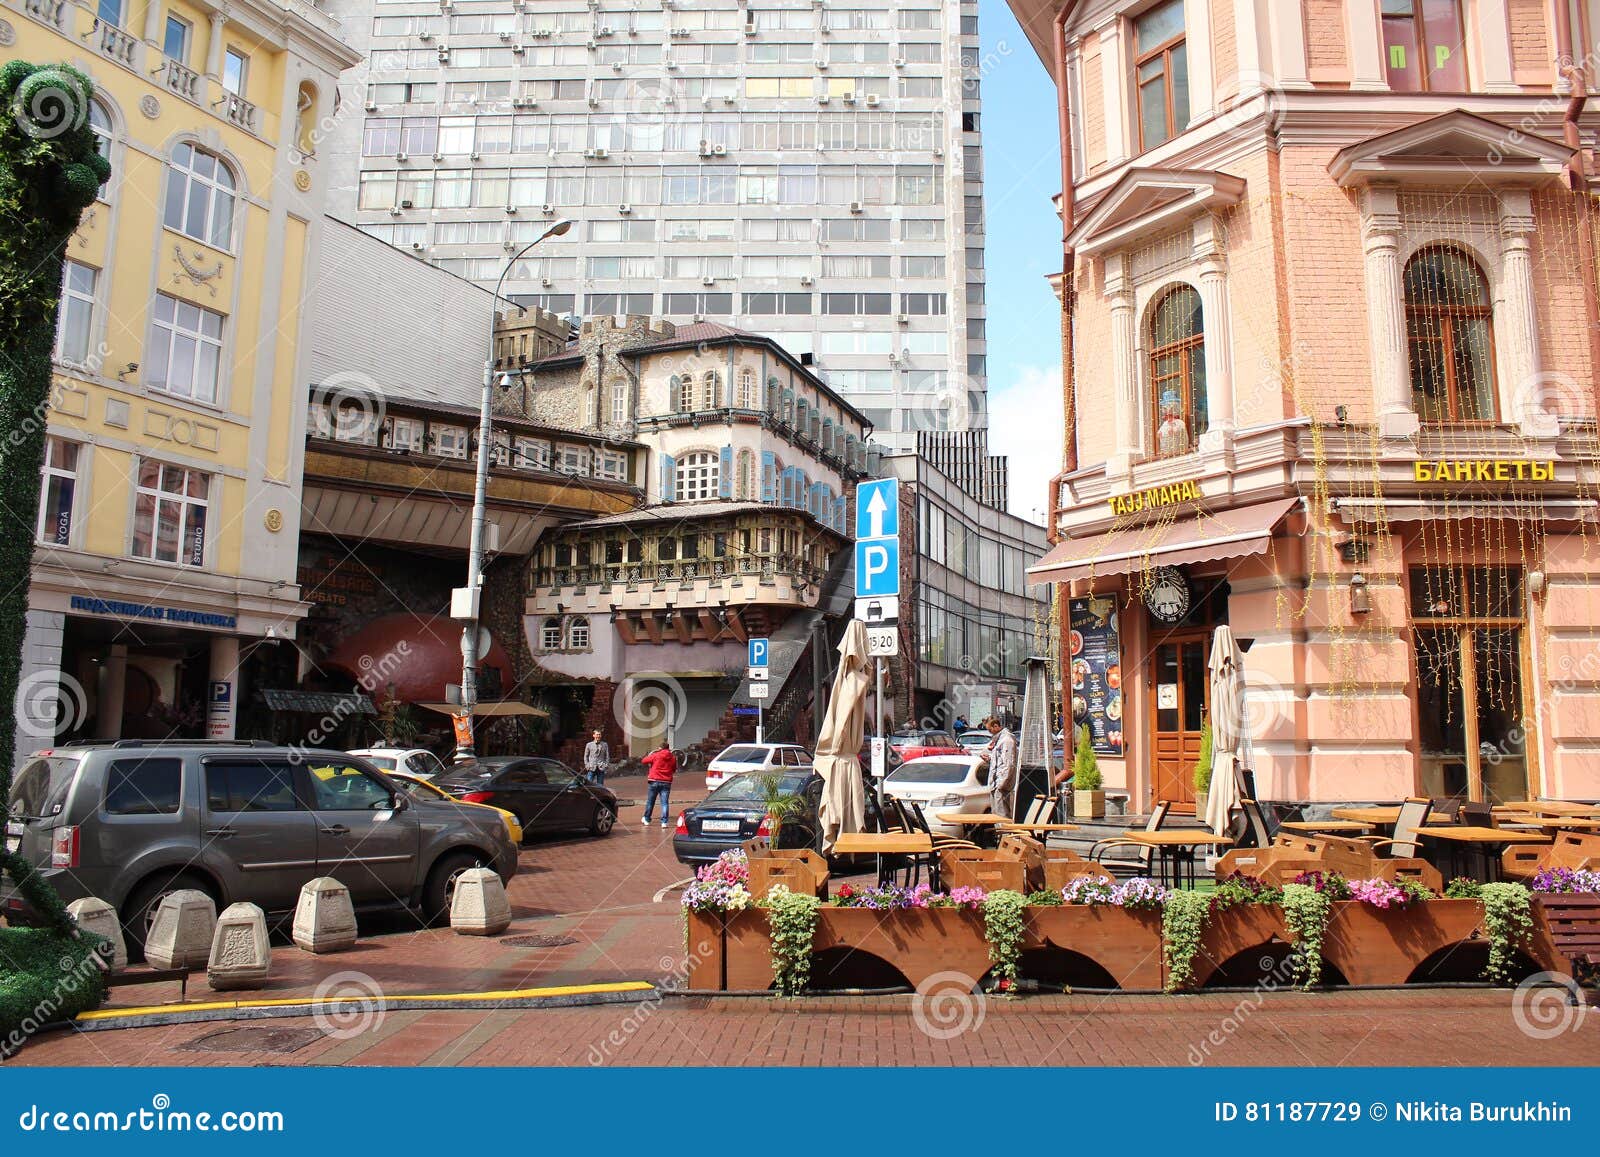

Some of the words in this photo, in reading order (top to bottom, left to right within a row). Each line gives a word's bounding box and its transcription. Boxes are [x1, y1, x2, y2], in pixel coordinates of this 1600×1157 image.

[1389, 45, 1407, 69] П
[1435, 45, 1451, 69] Р
[1414, 460, 1555, 482] БАНКЕТЫ
[1108, 492, 1143, 515] TAJJ
[1147, 480, 1201, 508] MAHAL
[58, 511, 69, 541] YOGA
[194, 527, 204, 563] STUDIO
[865, 545, 888, 590] P
[753, 641, 765, 664] P
[880, 635, 893, 648] 20
[214, 683, 228, 701] P
